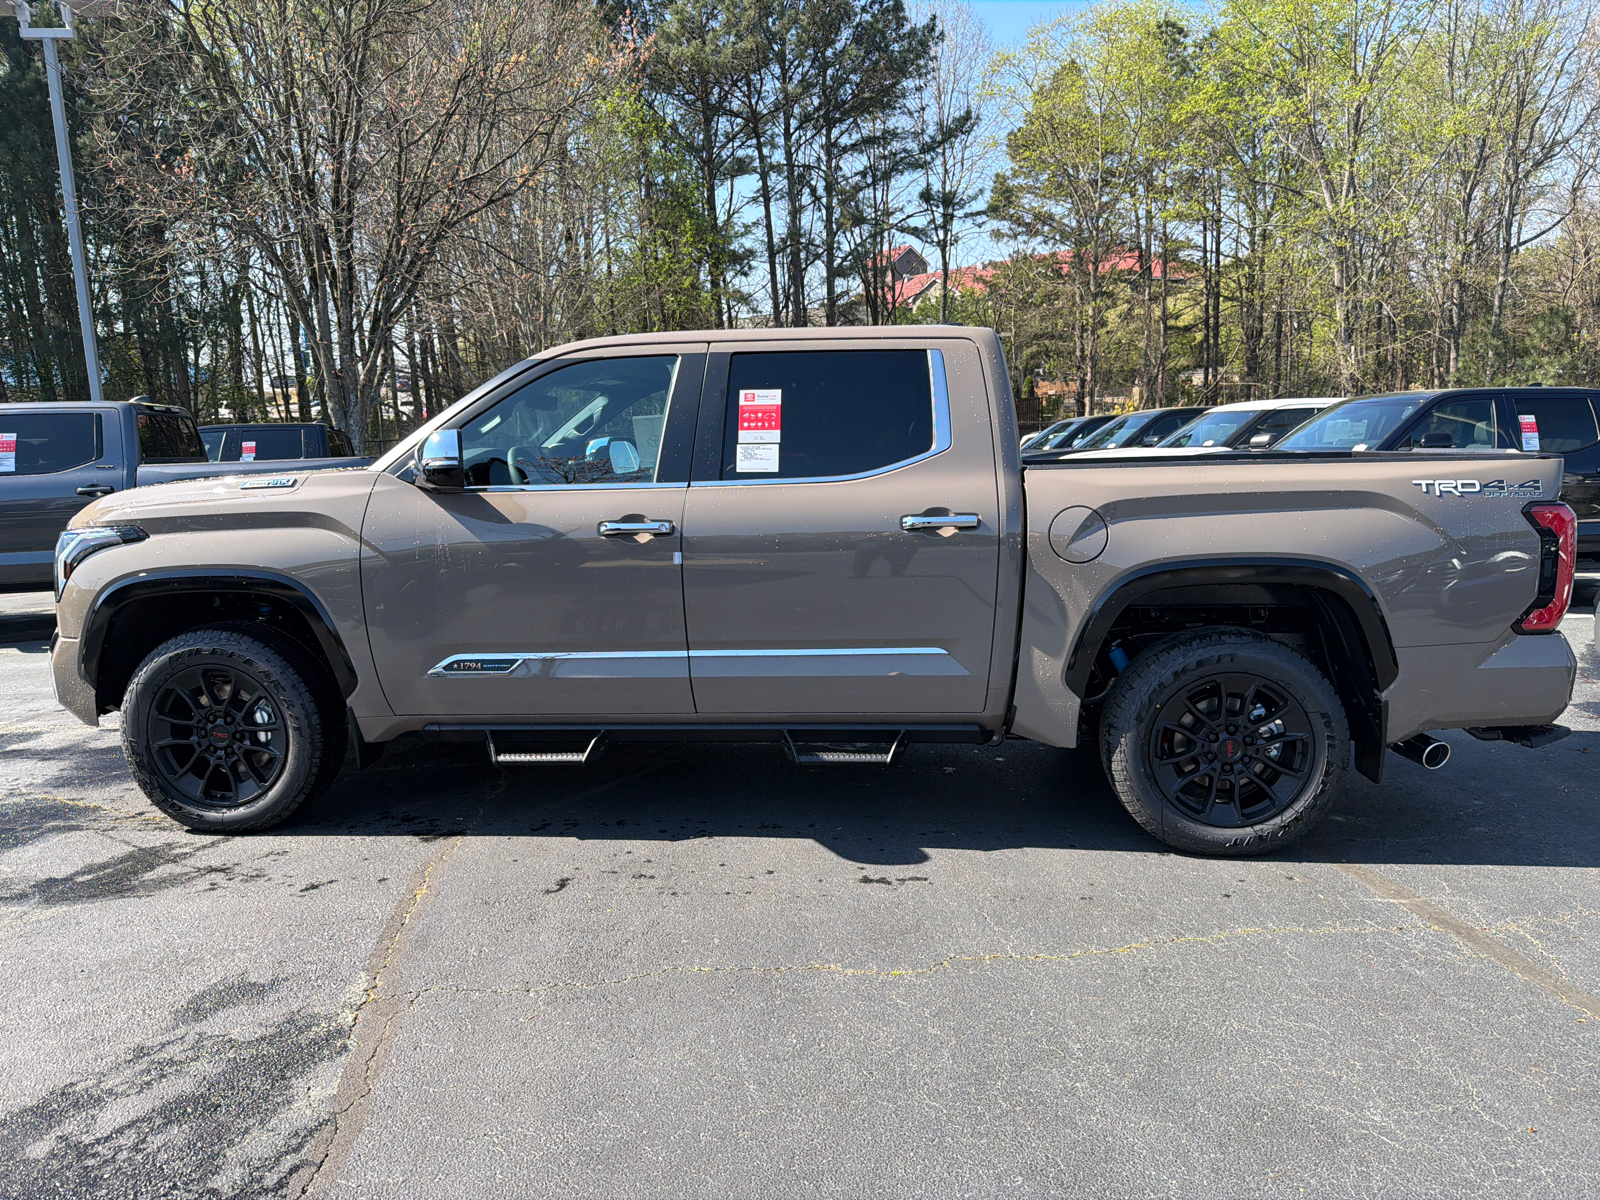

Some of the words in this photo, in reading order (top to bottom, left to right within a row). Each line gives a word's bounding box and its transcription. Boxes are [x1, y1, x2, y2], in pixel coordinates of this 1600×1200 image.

[1411, 479, 1481, 496] TRD
[1482, 479, 1543, 493] 4x4
[169, 647, 287, 695] WILDPEAK
[460, 662, 482, 670] 1794
[212, 731, 229, 739] TRD
[1226, 739, 1234, 758] TRD
